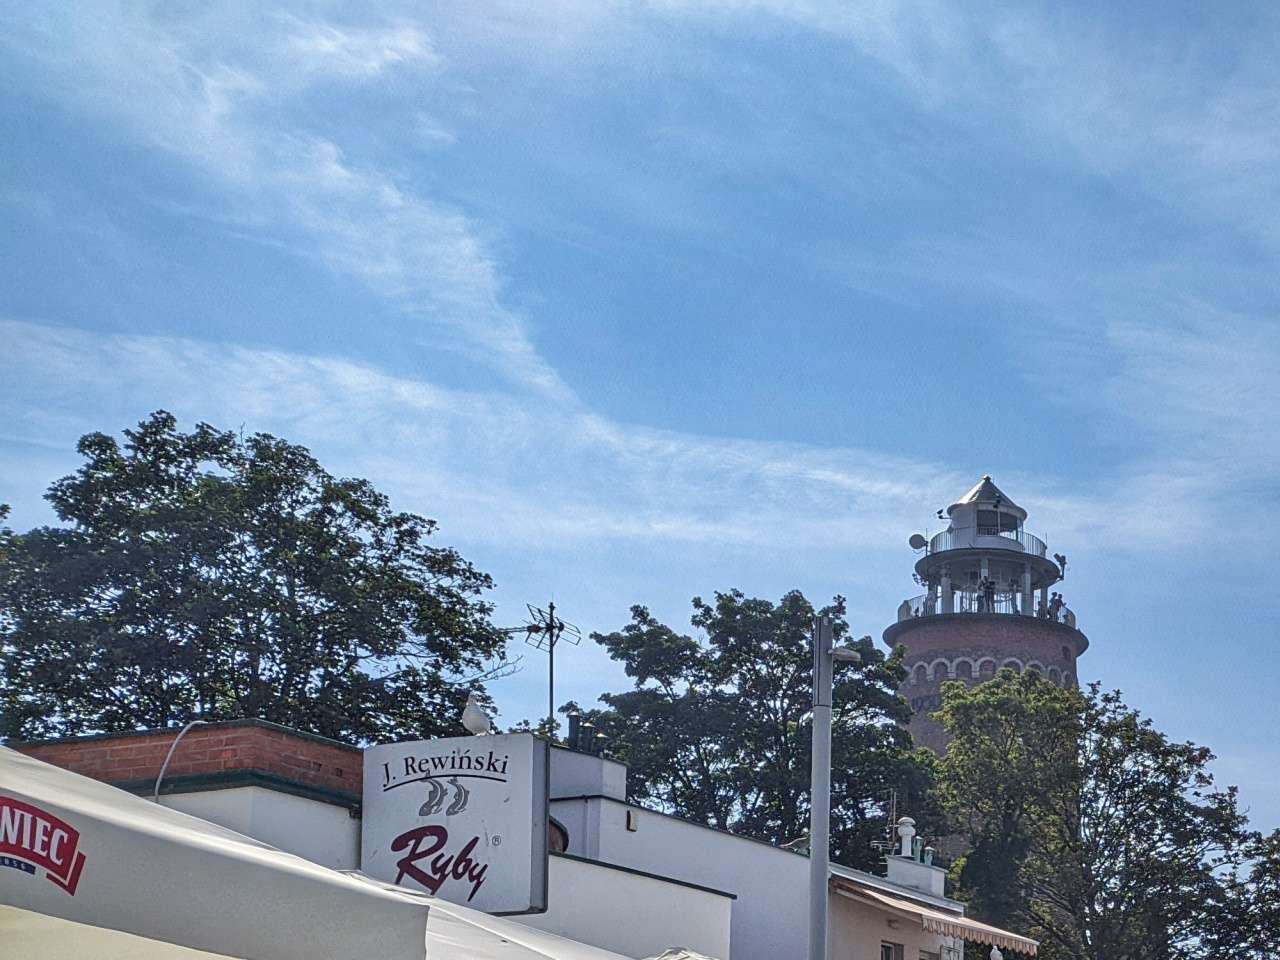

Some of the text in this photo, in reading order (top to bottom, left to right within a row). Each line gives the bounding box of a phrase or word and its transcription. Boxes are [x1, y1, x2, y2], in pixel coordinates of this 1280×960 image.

[383, 749, 509, 787] J. Rewiński
[0, 805, 69, 866] WIEC
[391, 825, 489, 902] Ryby
